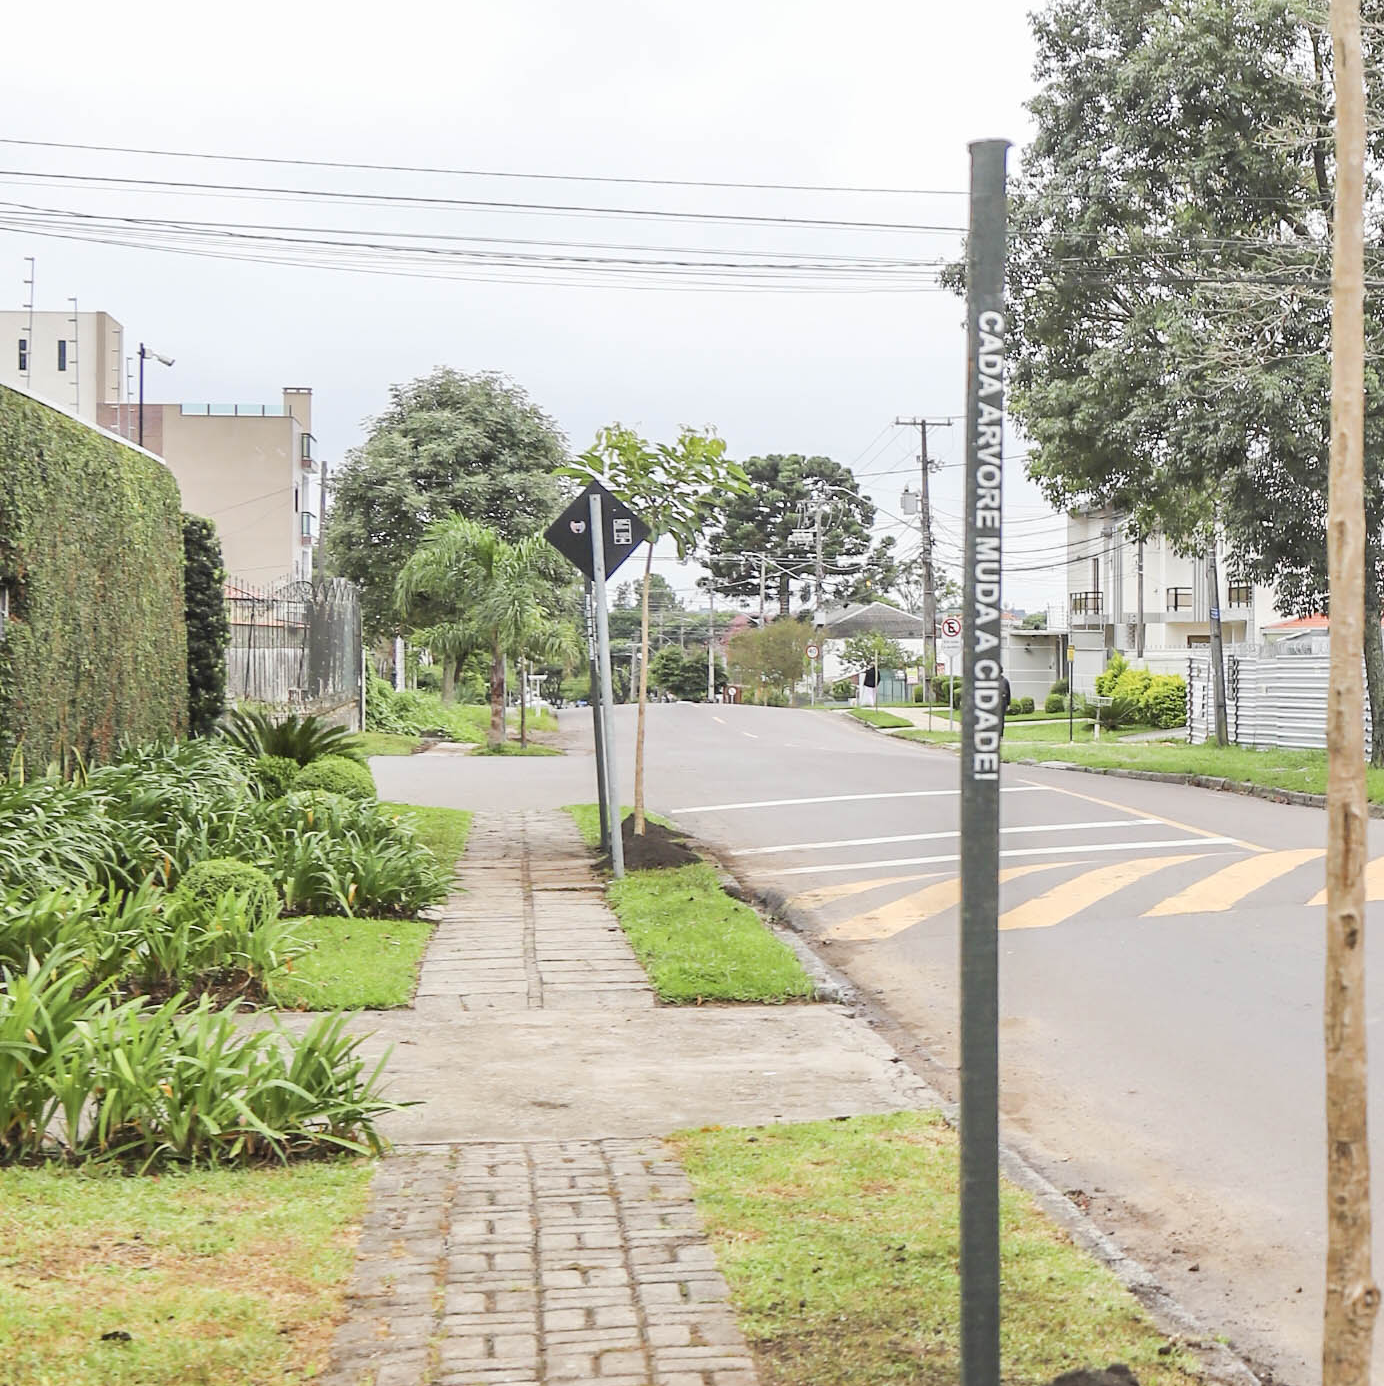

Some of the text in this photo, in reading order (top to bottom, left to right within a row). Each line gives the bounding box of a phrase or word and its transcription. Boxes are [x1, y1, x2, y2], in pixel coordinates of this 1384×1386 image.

[977, 311, 1004, 397] CADA
[974, 536, 1000, 626] MUDA
[974, 630, 999, 653] A
[973, 659, 999, 781] CIDADE!
